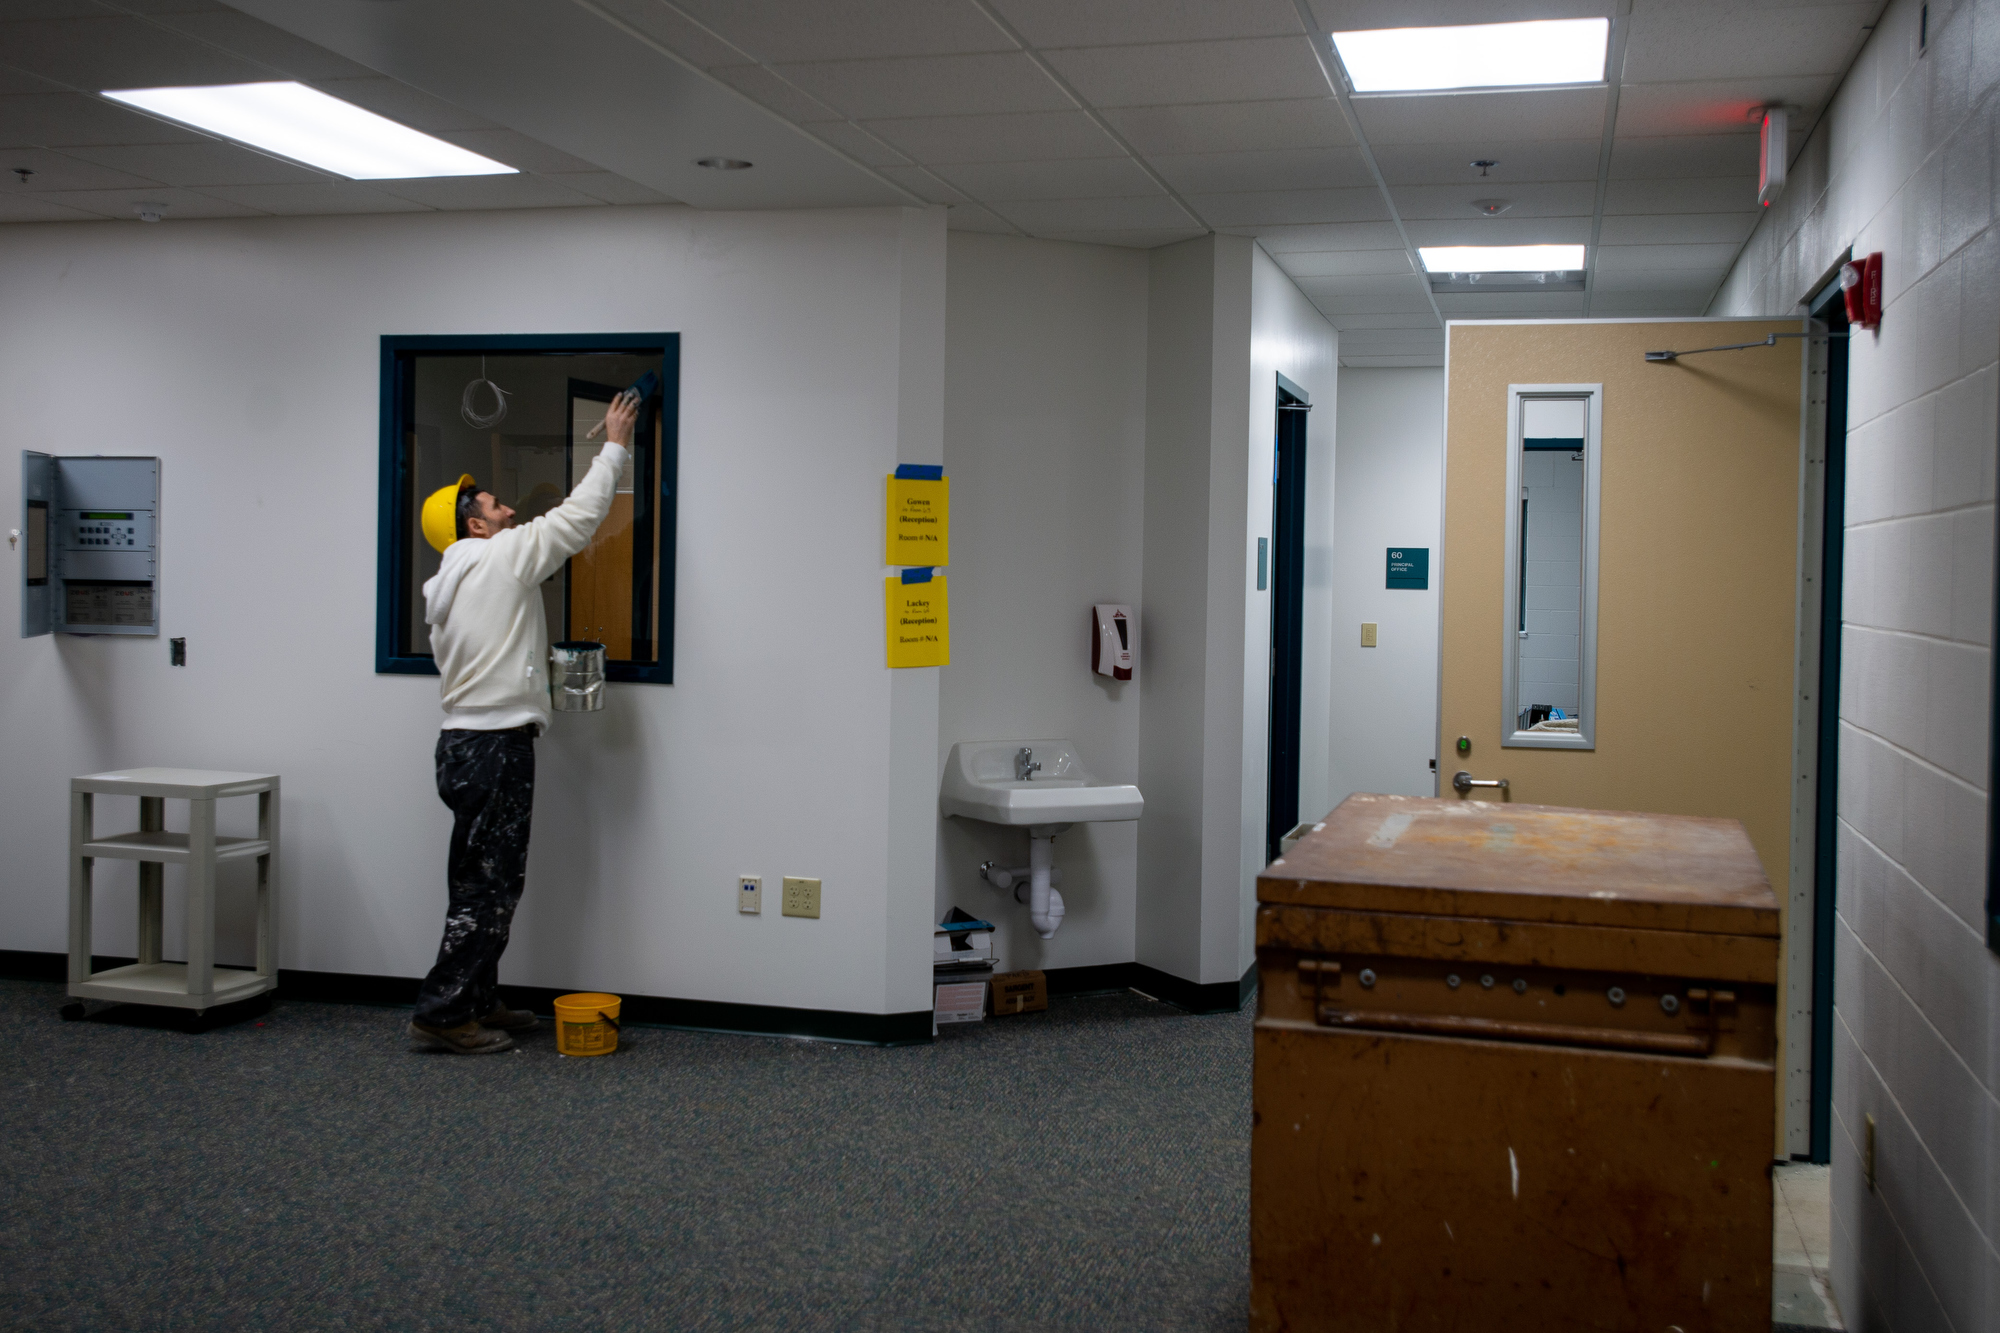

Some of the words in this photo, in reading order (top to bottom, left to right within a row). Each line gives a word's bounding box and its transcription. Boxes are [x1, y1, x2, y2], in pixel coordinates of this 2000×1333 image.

[899, 515, 938, 525] (Reception)
[898, 533, 918, 541] Room
[1391, 551, 1403, 559] 60
[899, 616, 938, 626] (Reception)
